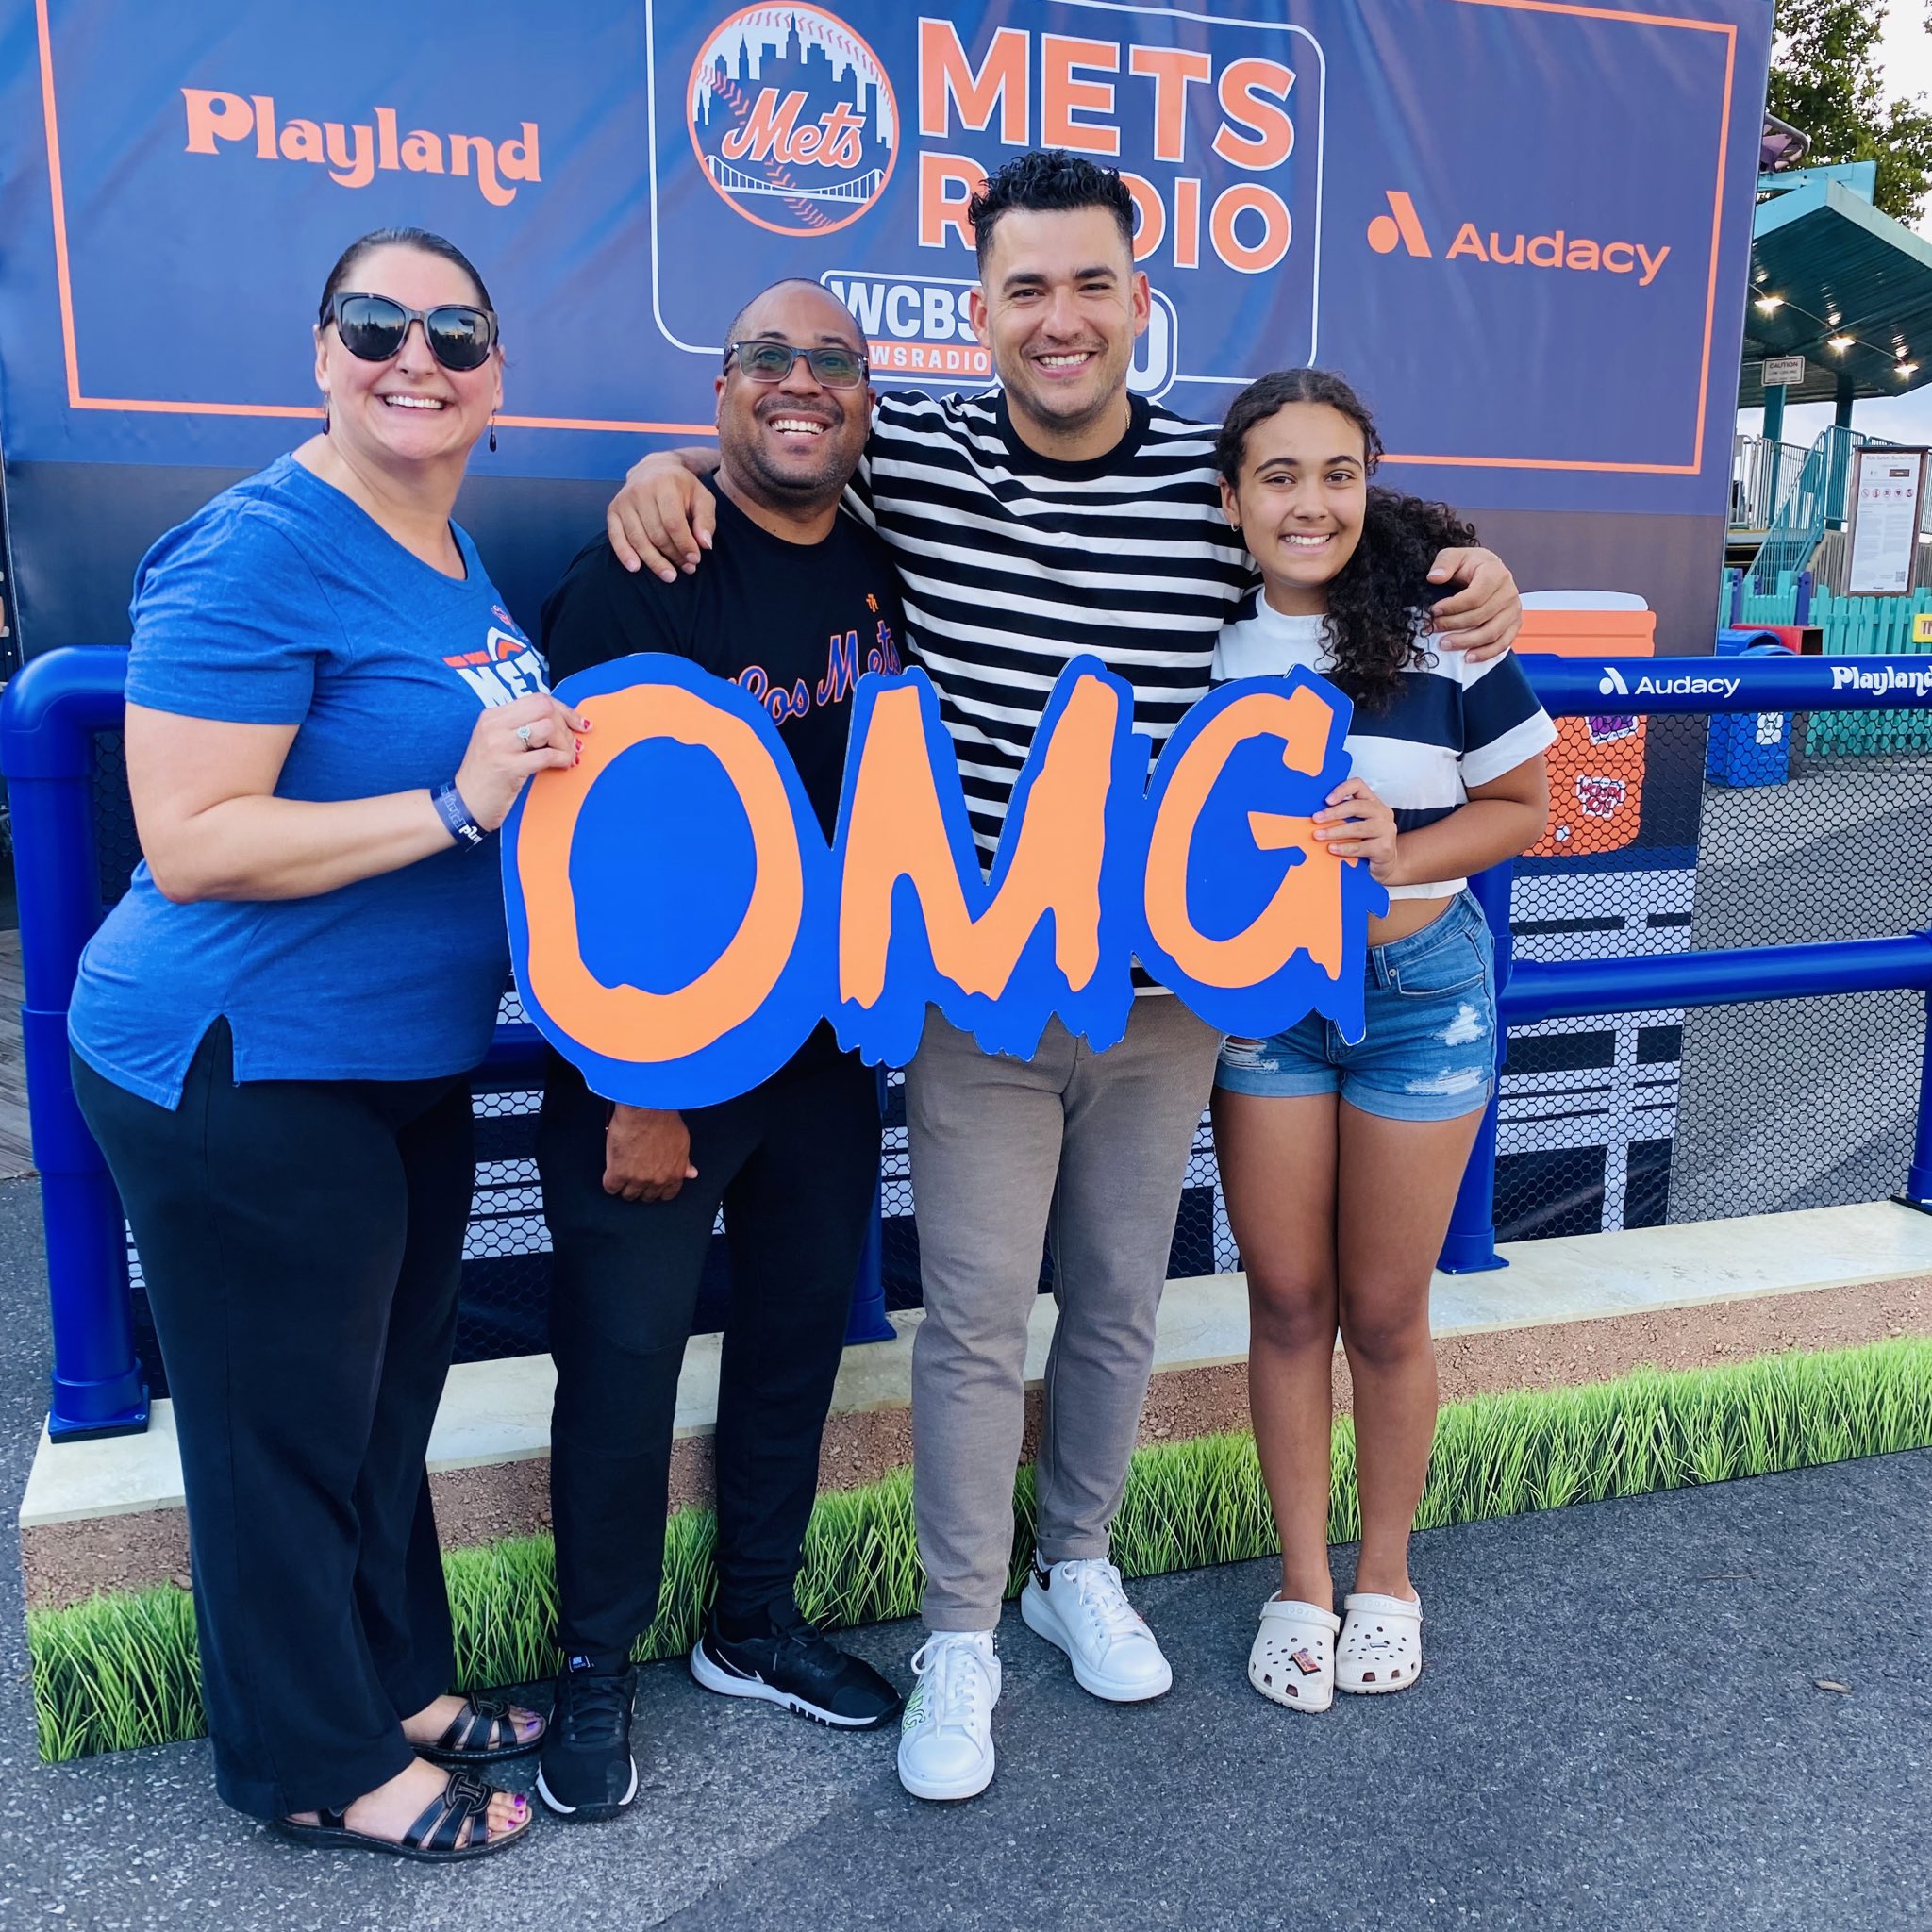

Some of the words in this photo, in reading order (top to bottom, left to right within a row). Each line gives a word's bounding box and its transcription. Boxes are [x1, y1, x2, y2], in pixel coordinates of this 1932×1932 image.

[721, 87, 867, 170] Mets
[916, 16, 1297, 172] METS
[180, 88, 542, 206] Playland
[917, 150, 1294, 275] RDIO
[1445, 223, 1671, 286] Audacy
[872, 345, 989, 372] WSRADIO
[817, 619, 901, 707] Mets
[1634, 675, 1741, 698] Audacy
[517, 673, 1359, 1063] OMG
